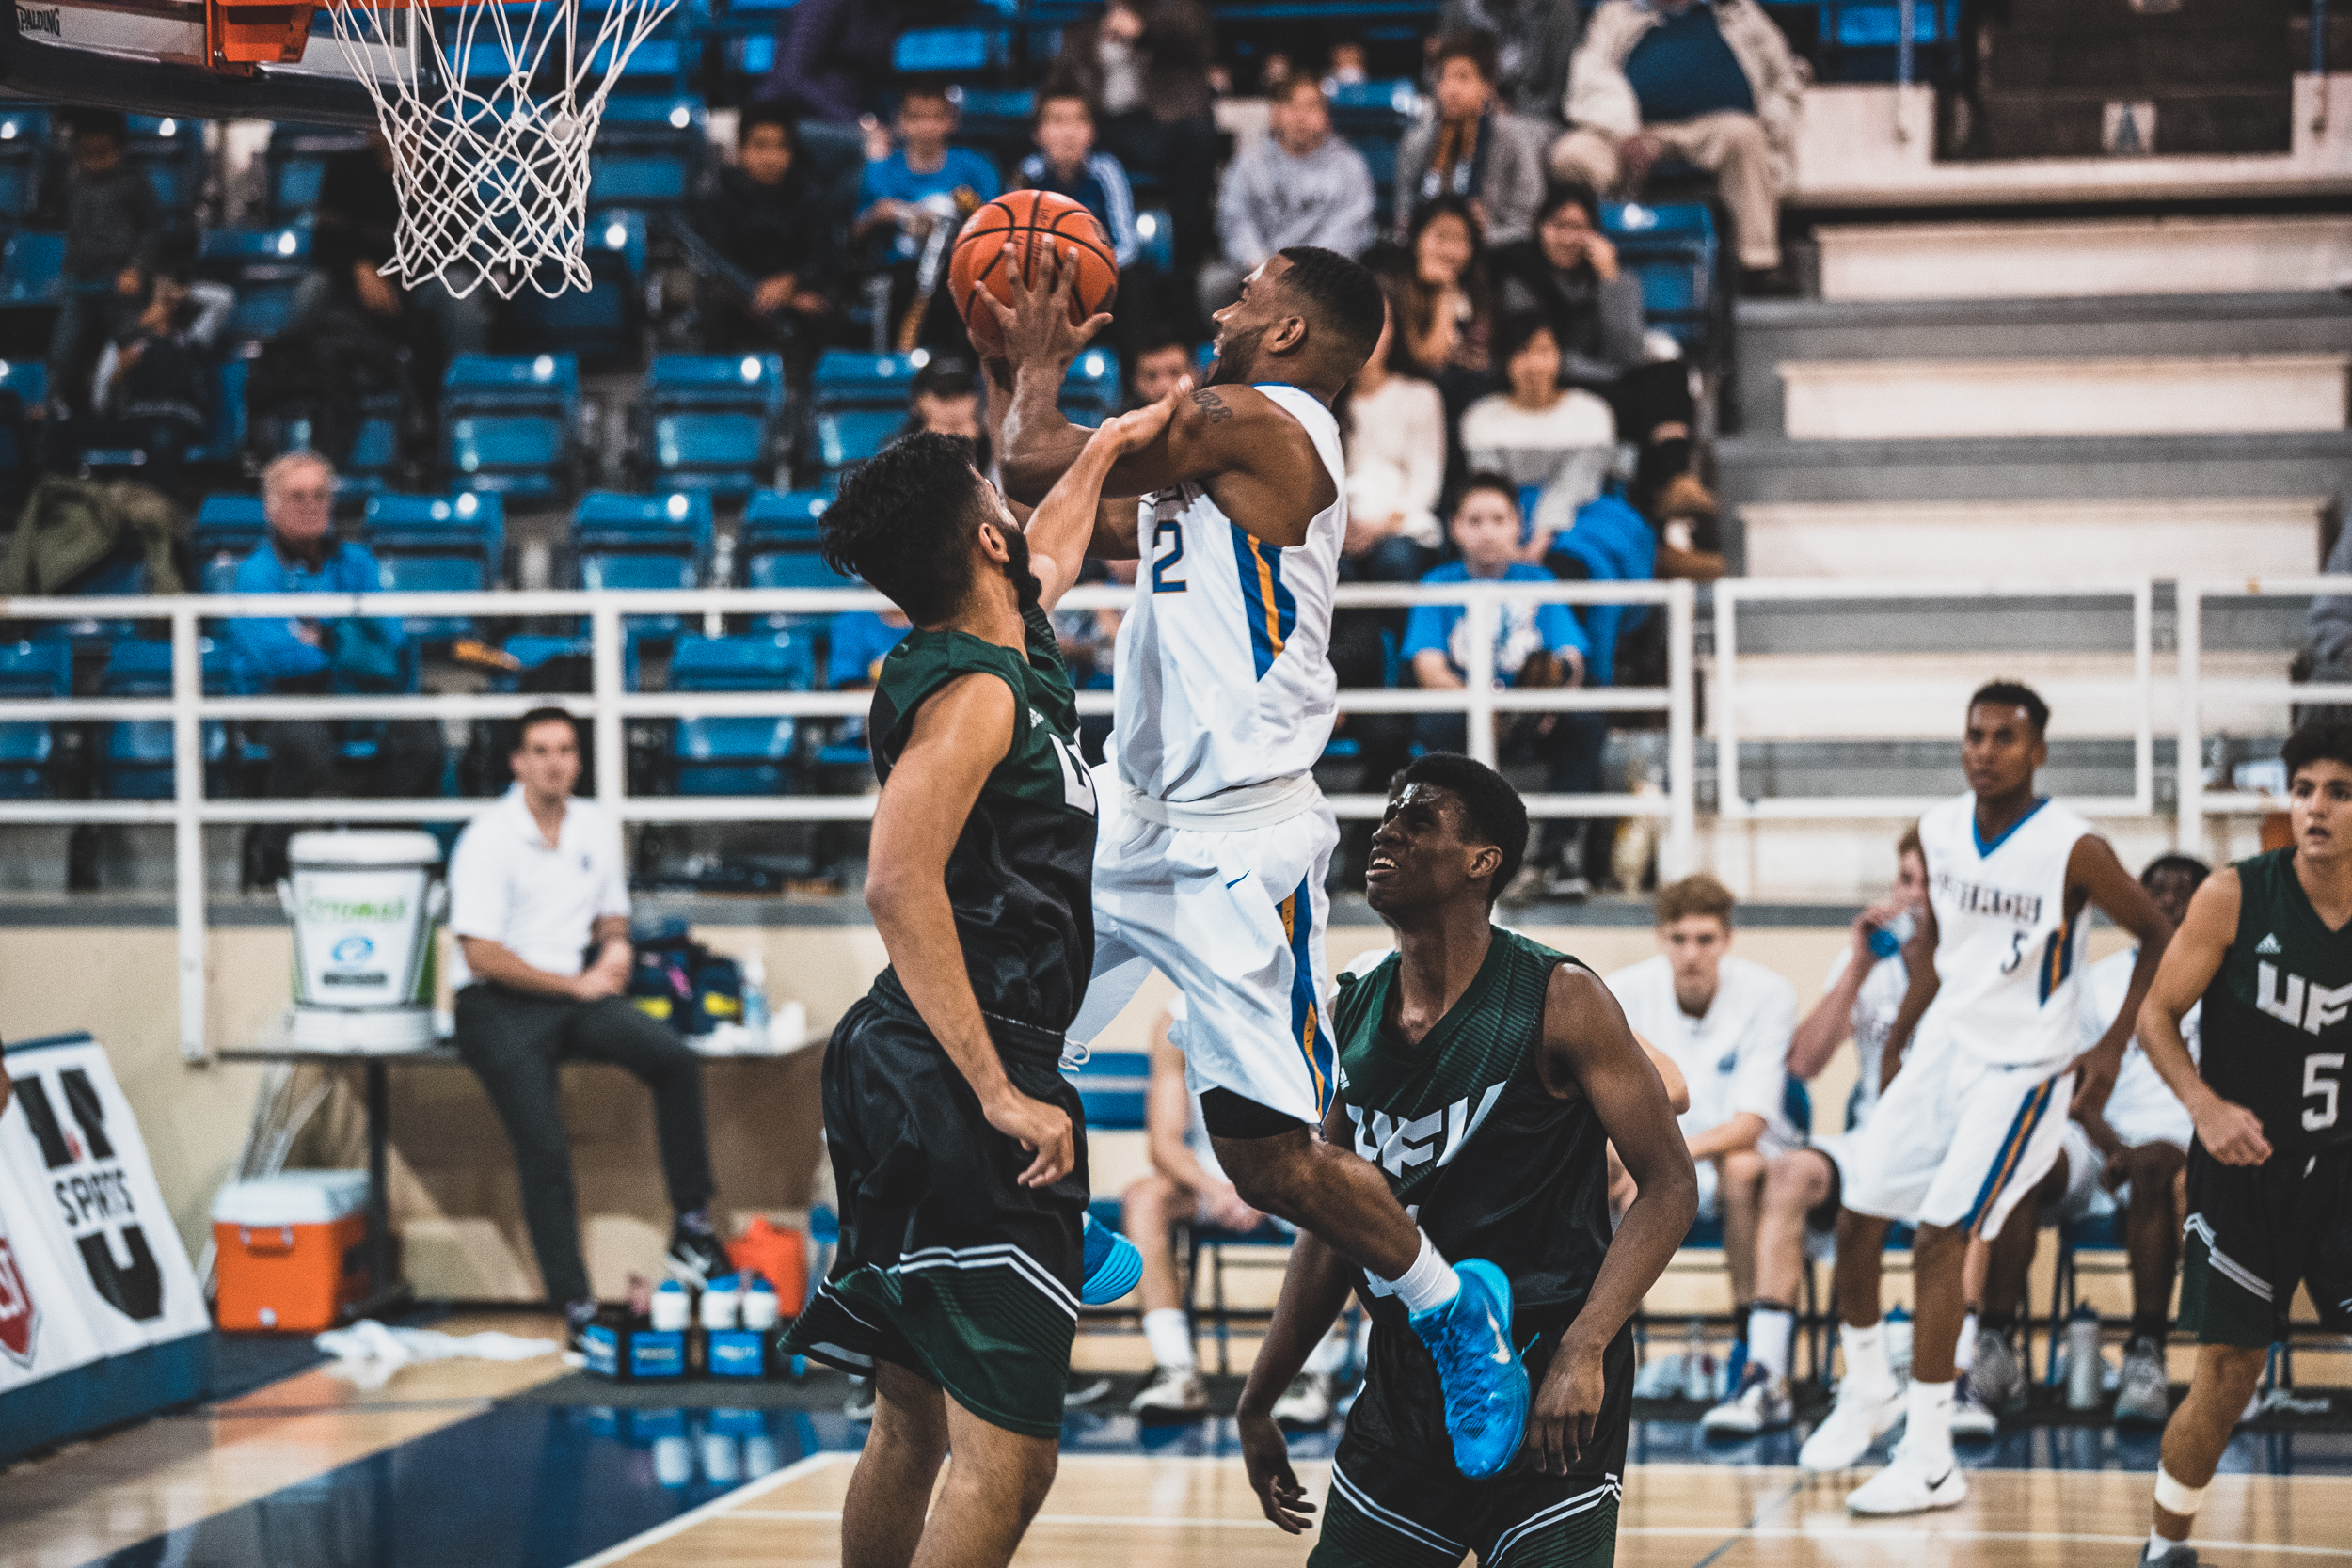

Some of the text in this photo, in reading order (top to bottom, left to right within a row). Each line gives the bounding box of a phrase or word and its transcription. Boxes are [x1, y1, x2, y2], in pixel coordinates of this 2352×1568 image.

[1152, 519, 1187, 594] 2
[2000, 929, 2028, 975] 5
[1345, 1080, 1507, 1179] UFV
[2301, 1053, 2346, 1132] 5
